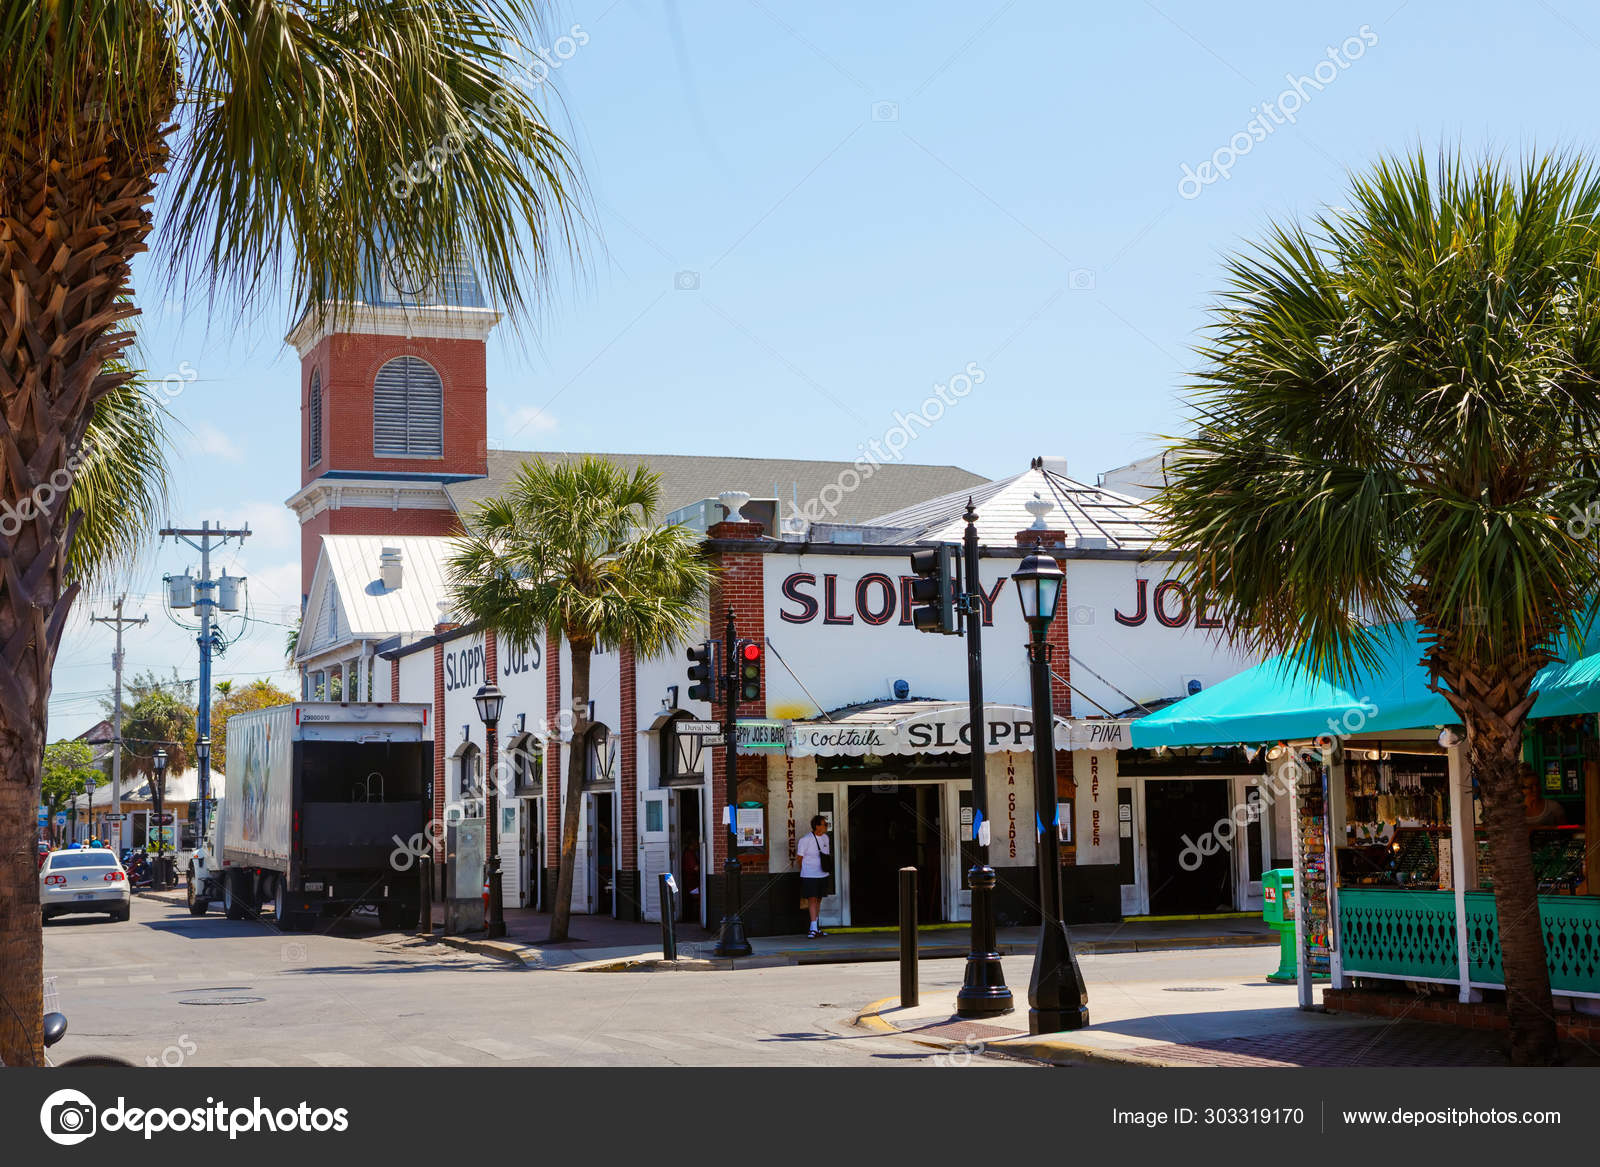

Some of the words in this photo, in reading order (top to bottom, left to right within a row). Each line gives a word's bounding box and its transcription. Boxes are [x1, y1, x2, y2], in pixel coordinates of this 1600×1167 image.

[779, 572, 1008, 627] SLOPY
[446, 644, 486, 691] SLOPPY
[504, 638, 541, 676] JOES
[684, 723, 704, 731] Duval
[770, 726, 785, 743] BAR
[810, 729, 884, 746] Cocktails
[908, 721, 1060, 748] SLPP
[1090, 724, 1122, 743] PINA
[1090, 756, 1099, 803] DRAFT
[1008, 792, 1017, 859] COLADAS
[1092, 810, 1100, 847] BEER
